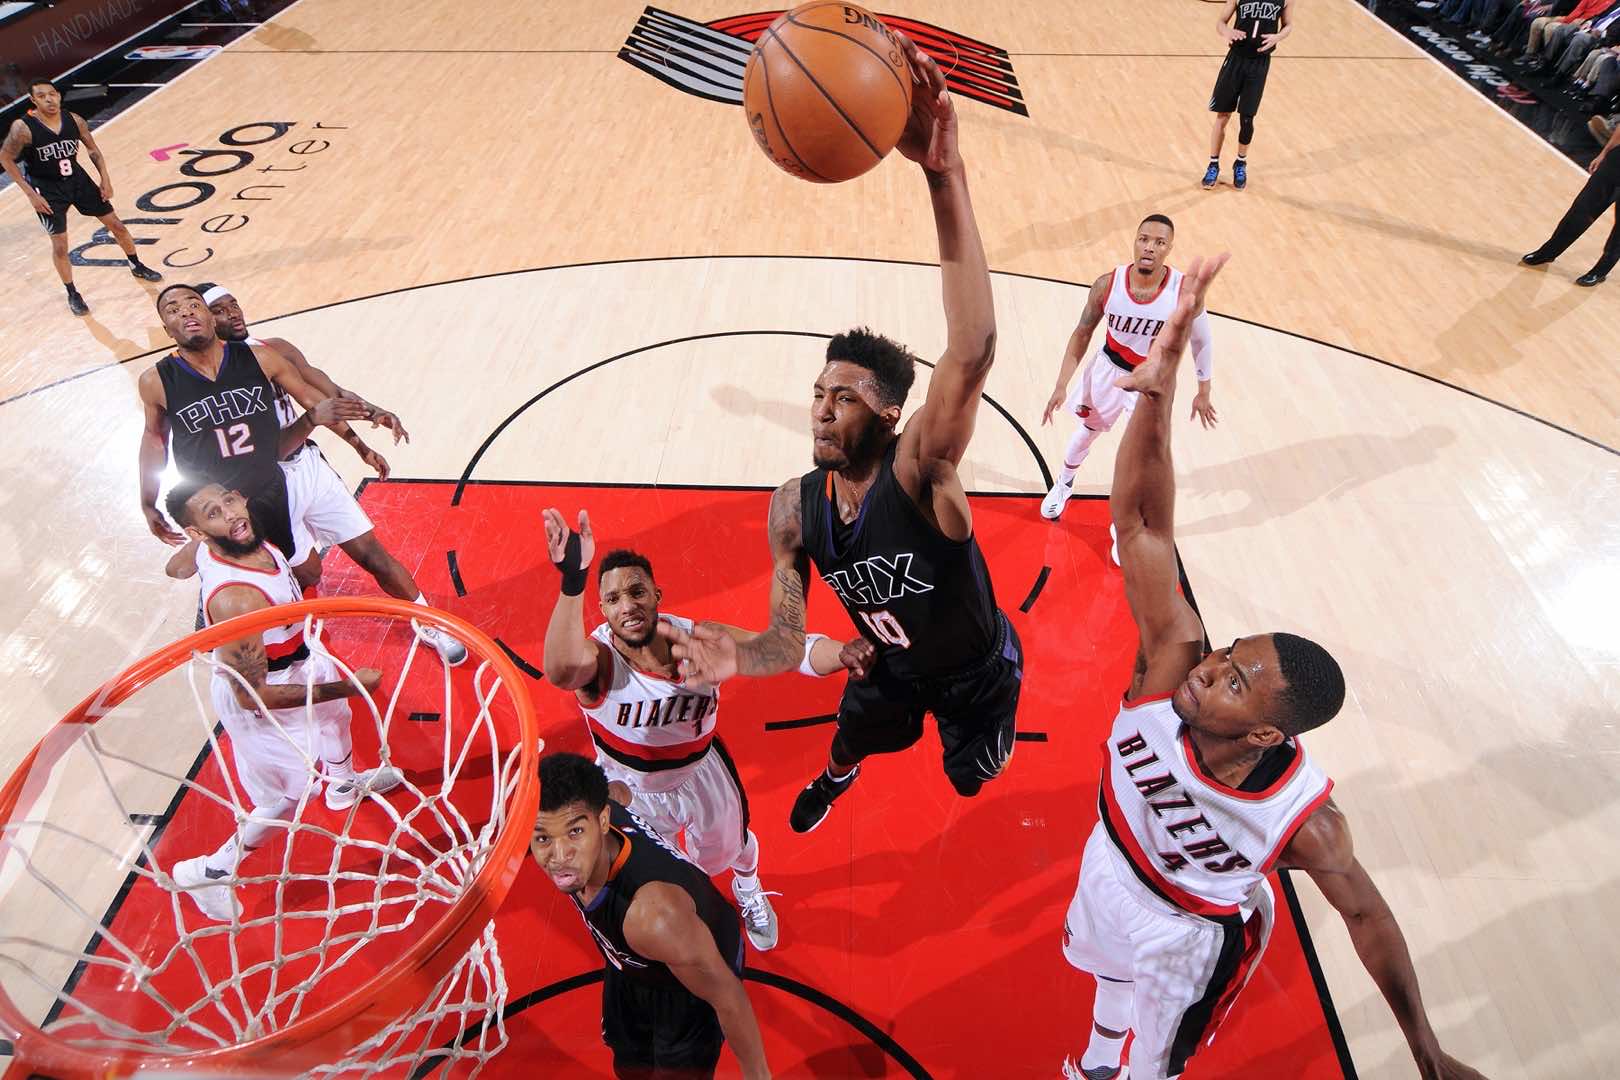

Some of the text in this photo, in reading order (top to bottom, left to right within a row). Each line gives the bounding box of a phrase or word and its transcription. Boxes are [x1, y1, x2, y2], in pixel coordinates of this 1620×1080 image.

[1240, 2, 1281, 20] PHX
[1251, 20, 1260, 38] 1
[36, 139, 80, 161] PHX
[59, 159, 73, 176] 8
[69, 121, 297, 267] moda
[162, 121, 349, 267] center
[1108, 313, 1165, 337] BLAZER
[176, 386, 268, 434] PHX
[214, 422, 254, 459] 12
[858, 610, 912, 649] 10
[691, 718, 702, 738] 1
[1116, 728, 1252, 873] BLAZERS
[1157, 851, 1190, 873] 4
